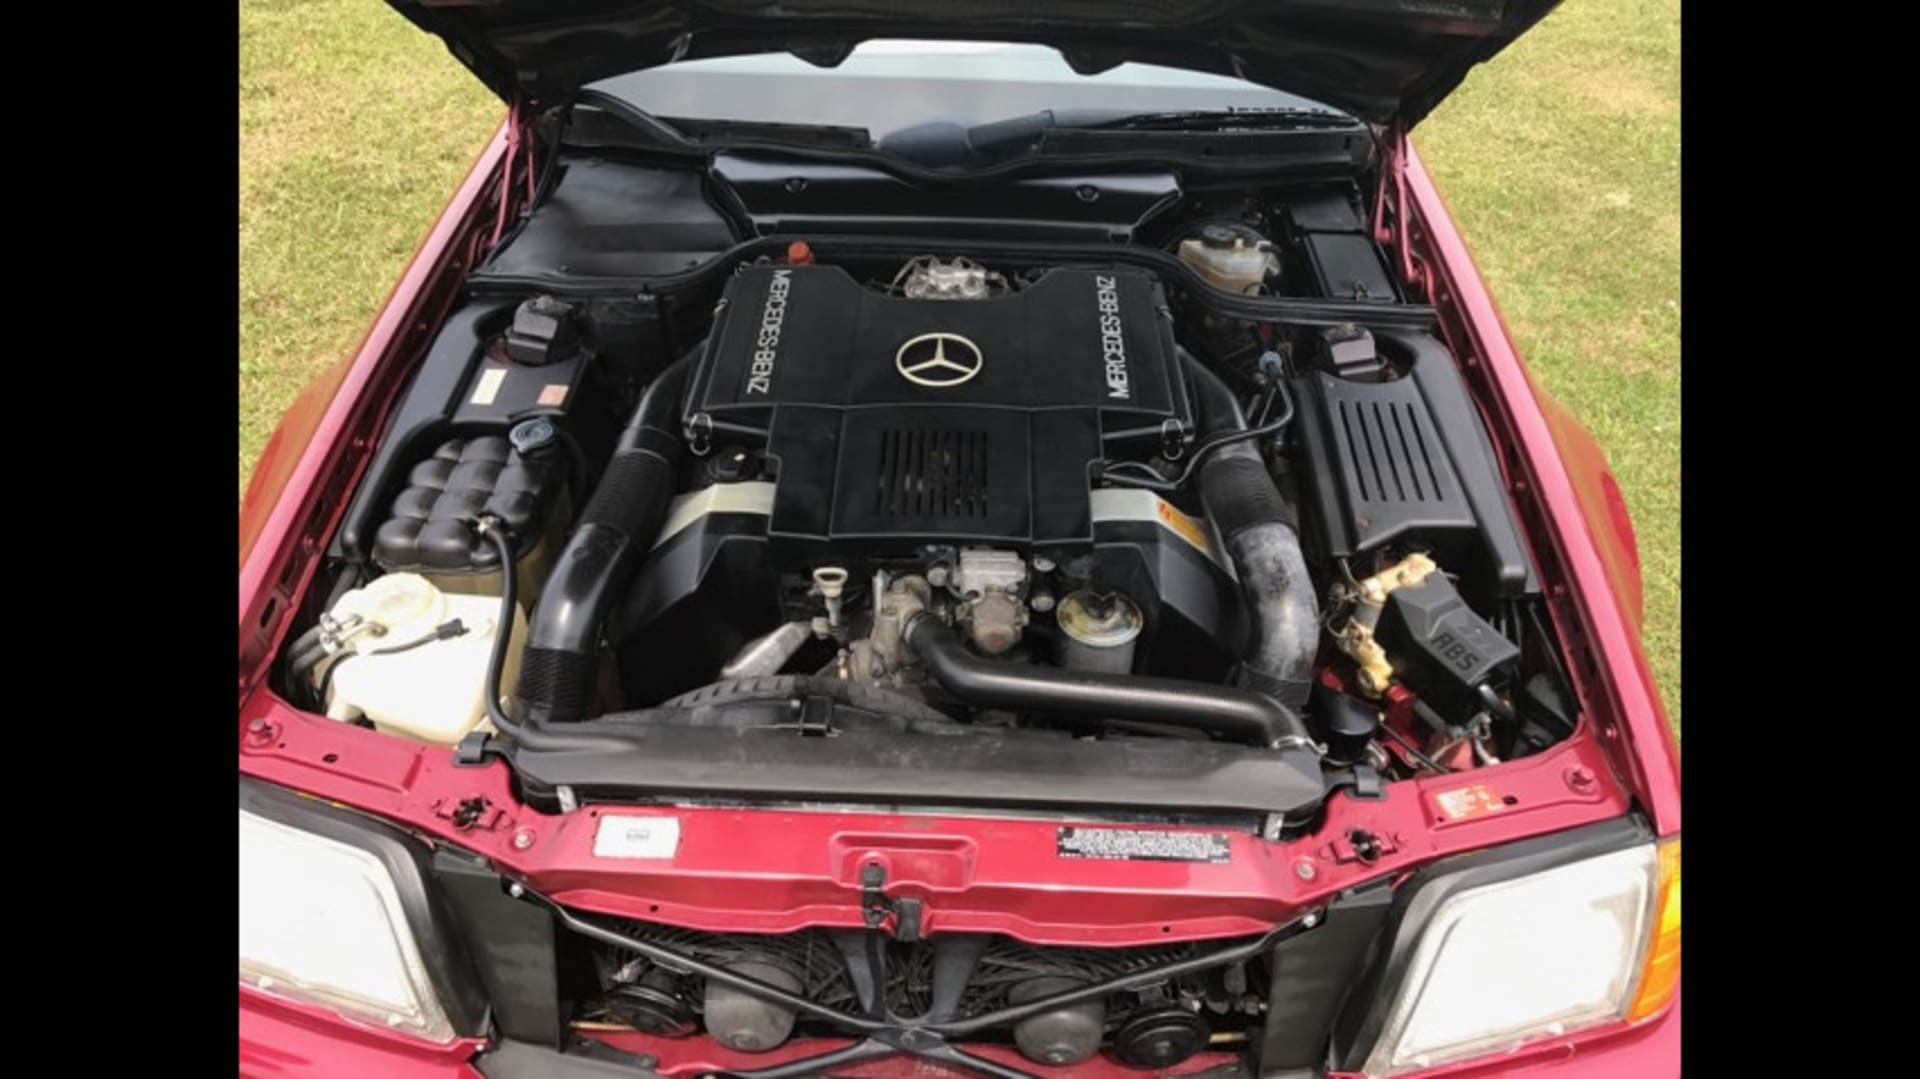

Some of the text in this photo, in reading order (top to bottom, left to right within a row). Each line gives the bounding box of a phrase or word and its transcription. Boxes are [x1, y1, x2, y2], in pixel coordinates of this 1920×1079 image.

[746, 269, 792, 394] MERCEDES-BENZ
[1096, 275, 1130, 399] MERCEDES-BENZ
[1431, 631, 1479, 671] ABS
